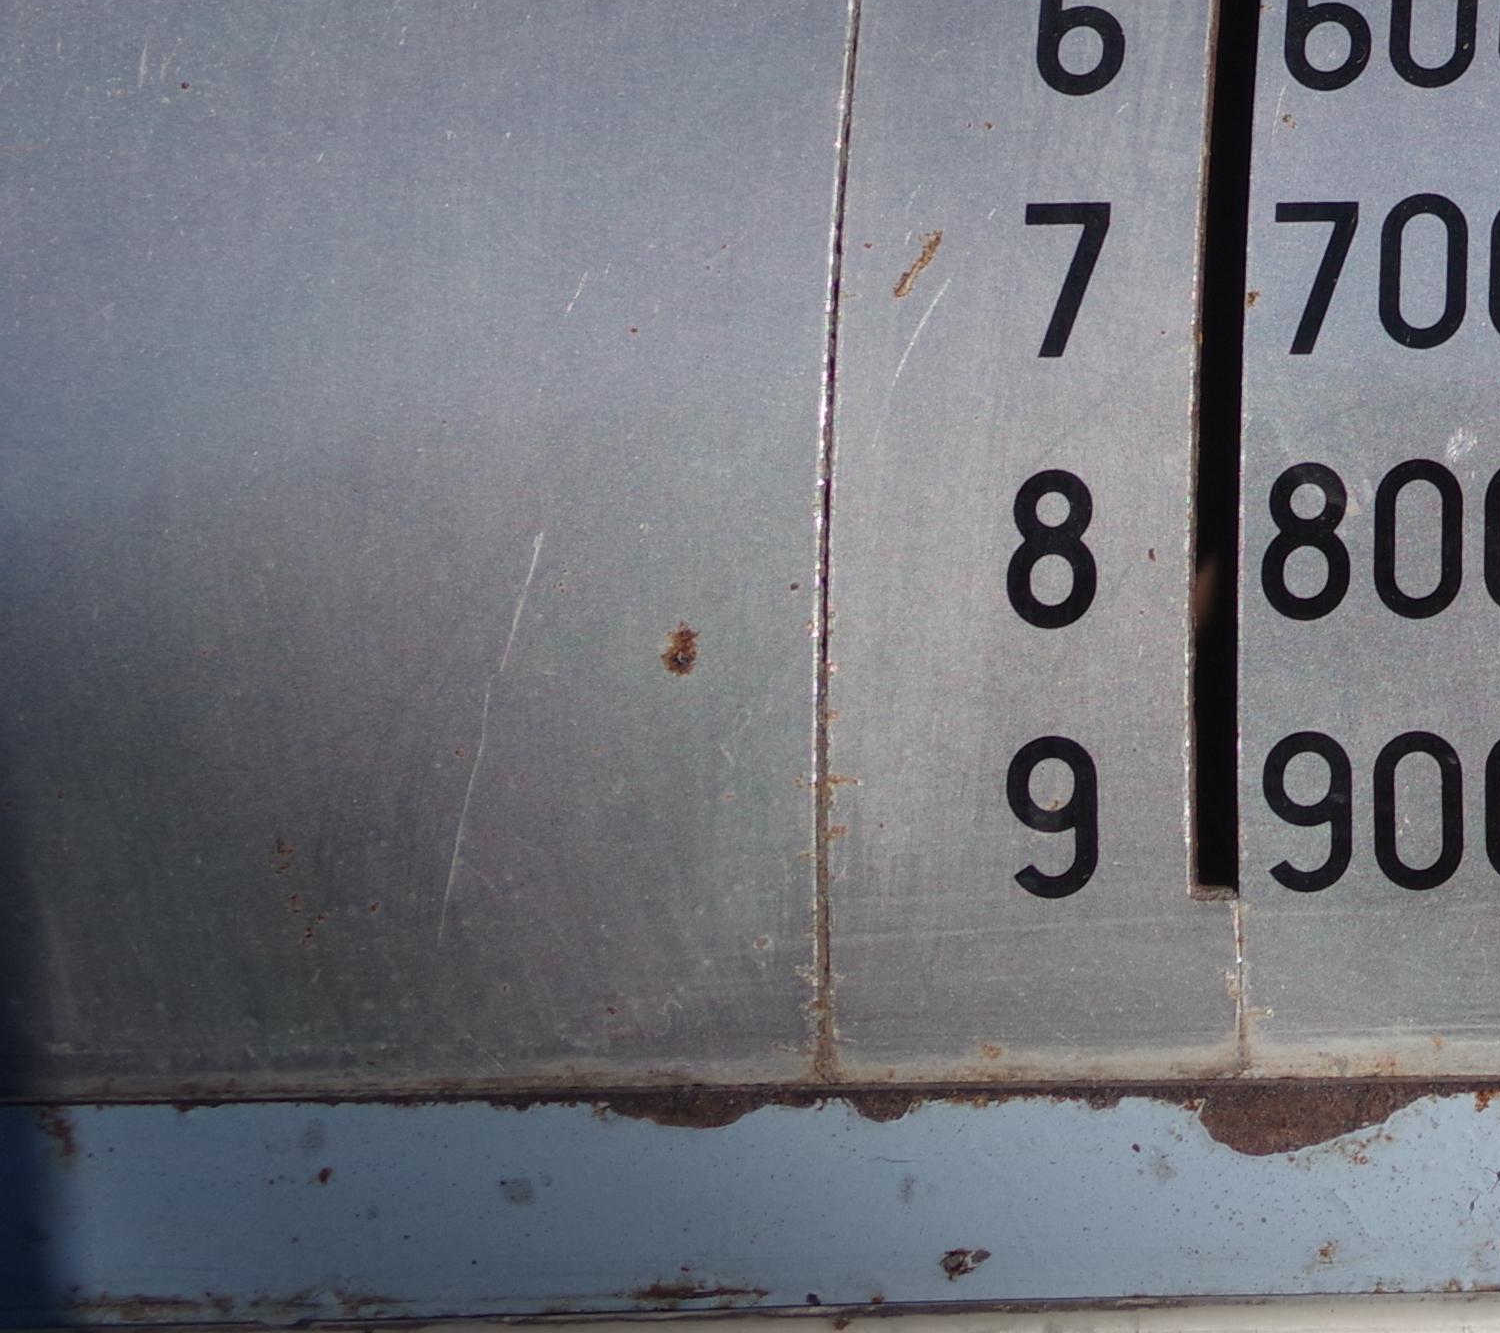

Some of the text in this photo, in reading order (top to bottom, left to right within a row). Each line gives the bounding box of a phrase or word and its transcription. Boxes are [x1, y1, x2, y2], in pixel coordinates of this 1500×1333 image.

[1025, 202, 1111, 357] 7
[1007, 469, 1097, 629] 8
[1006, 736, 1098, 899] 9
